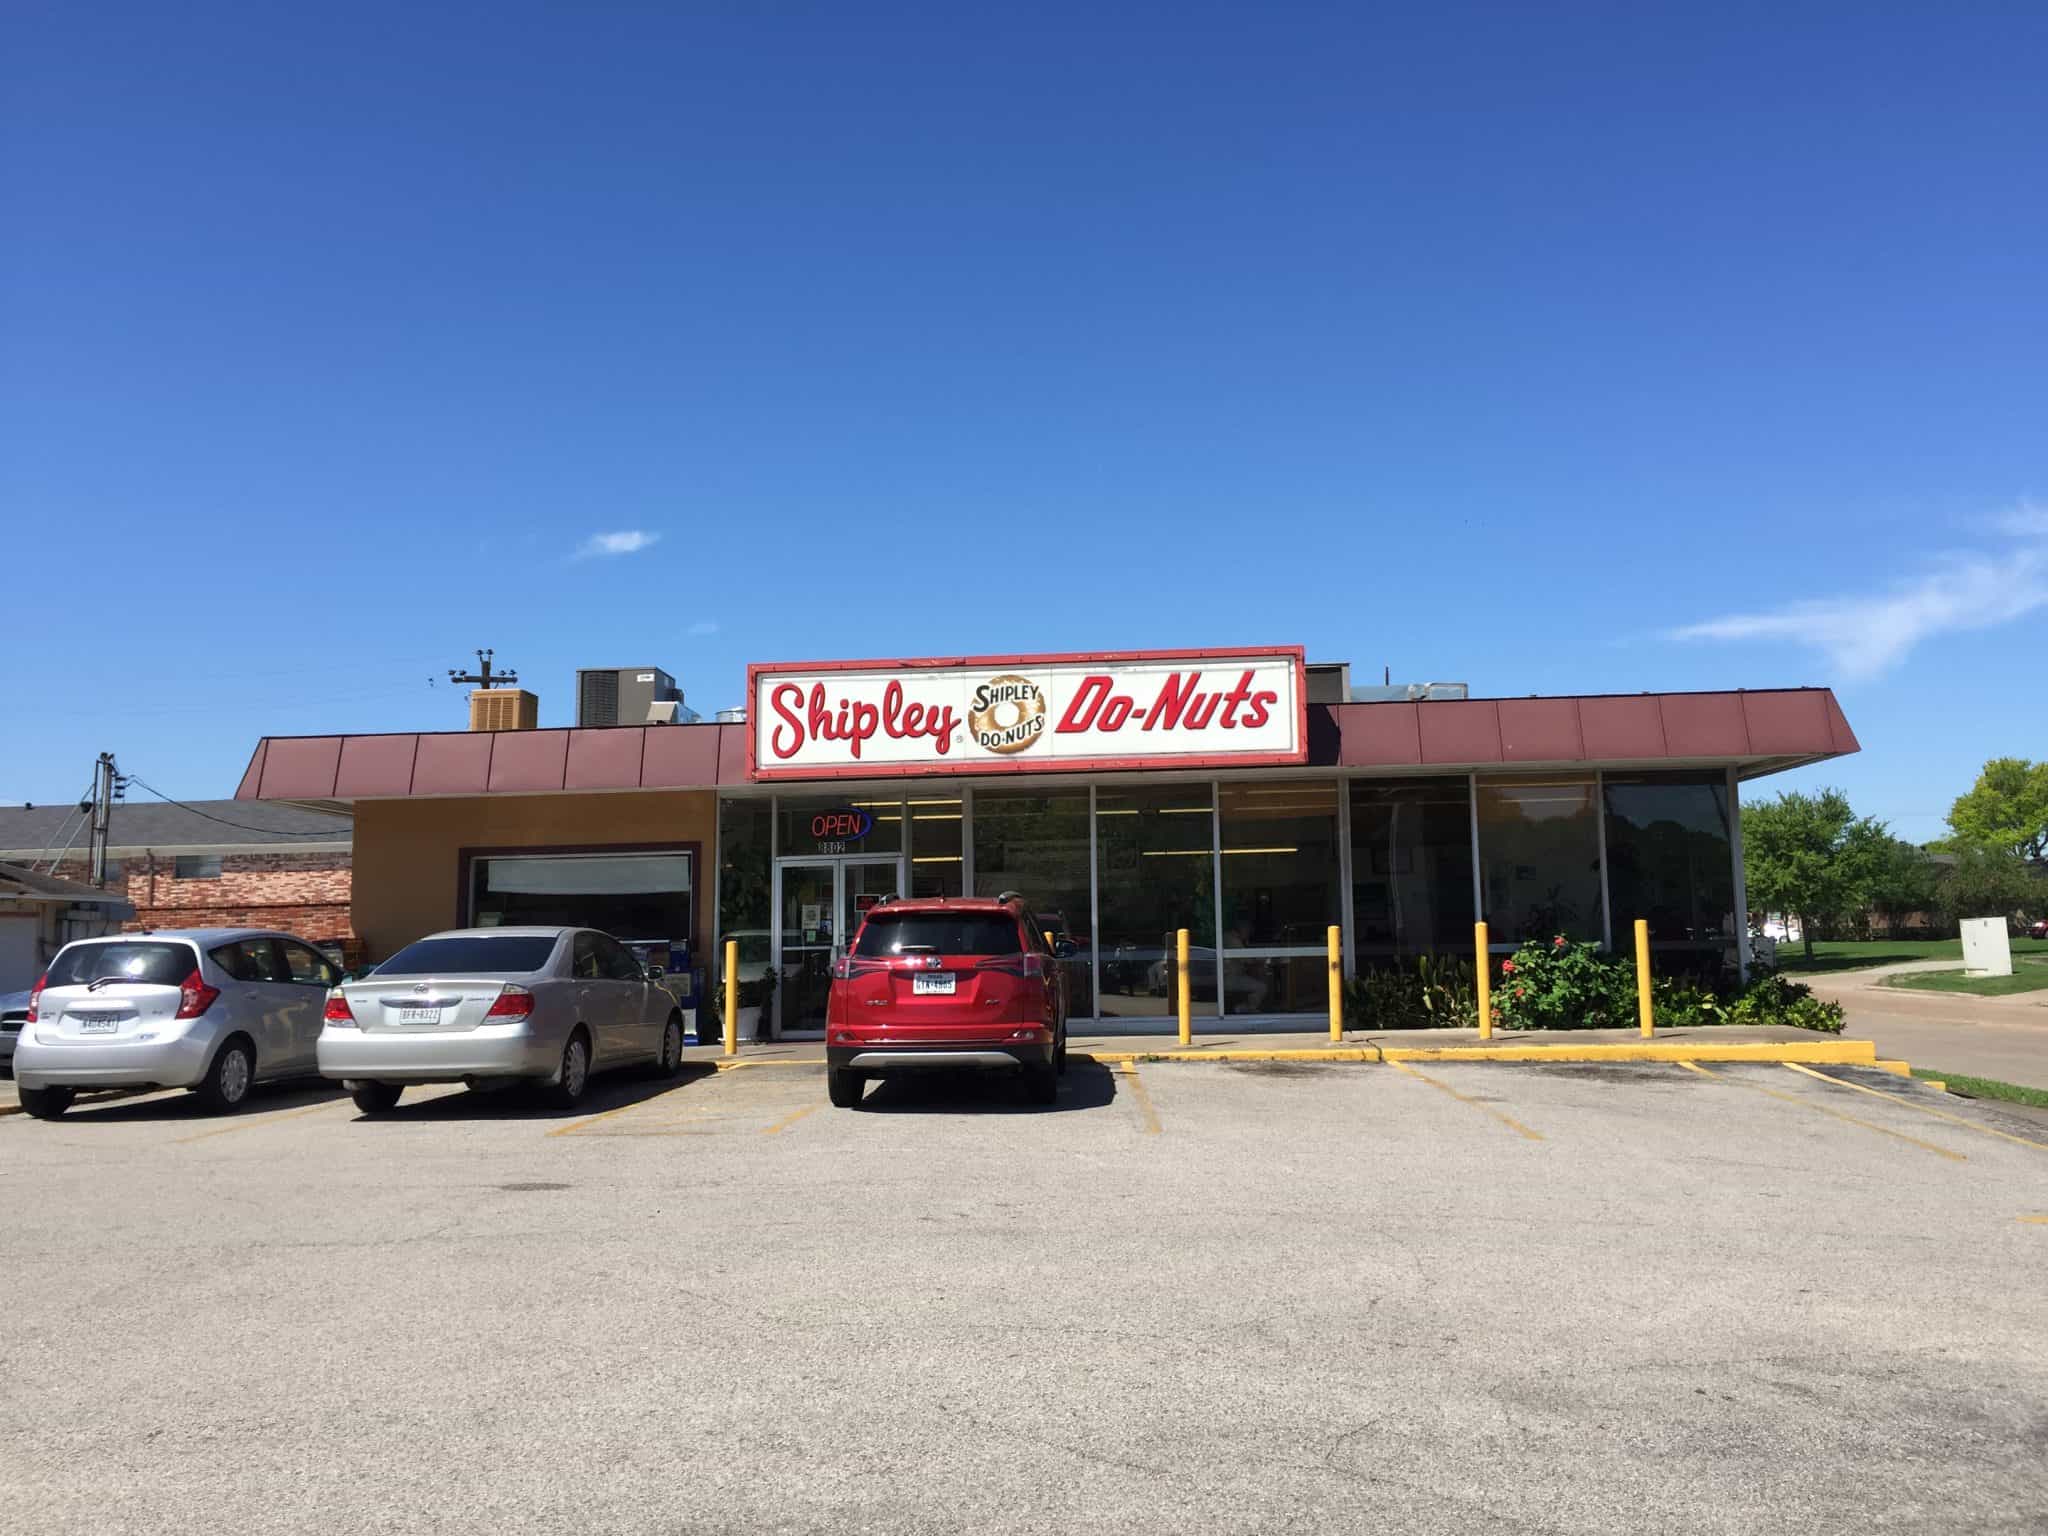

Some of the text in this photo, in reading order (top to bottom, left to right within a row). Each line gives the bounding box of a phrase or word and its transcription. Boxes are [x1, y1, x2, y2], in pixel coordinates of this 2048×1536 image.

[973, 685, 1039, 712] SHIPLEY
[771, 669, 1278, 759] Shipley Do-Nuts
[812, 814, 861, 836] OPEN
